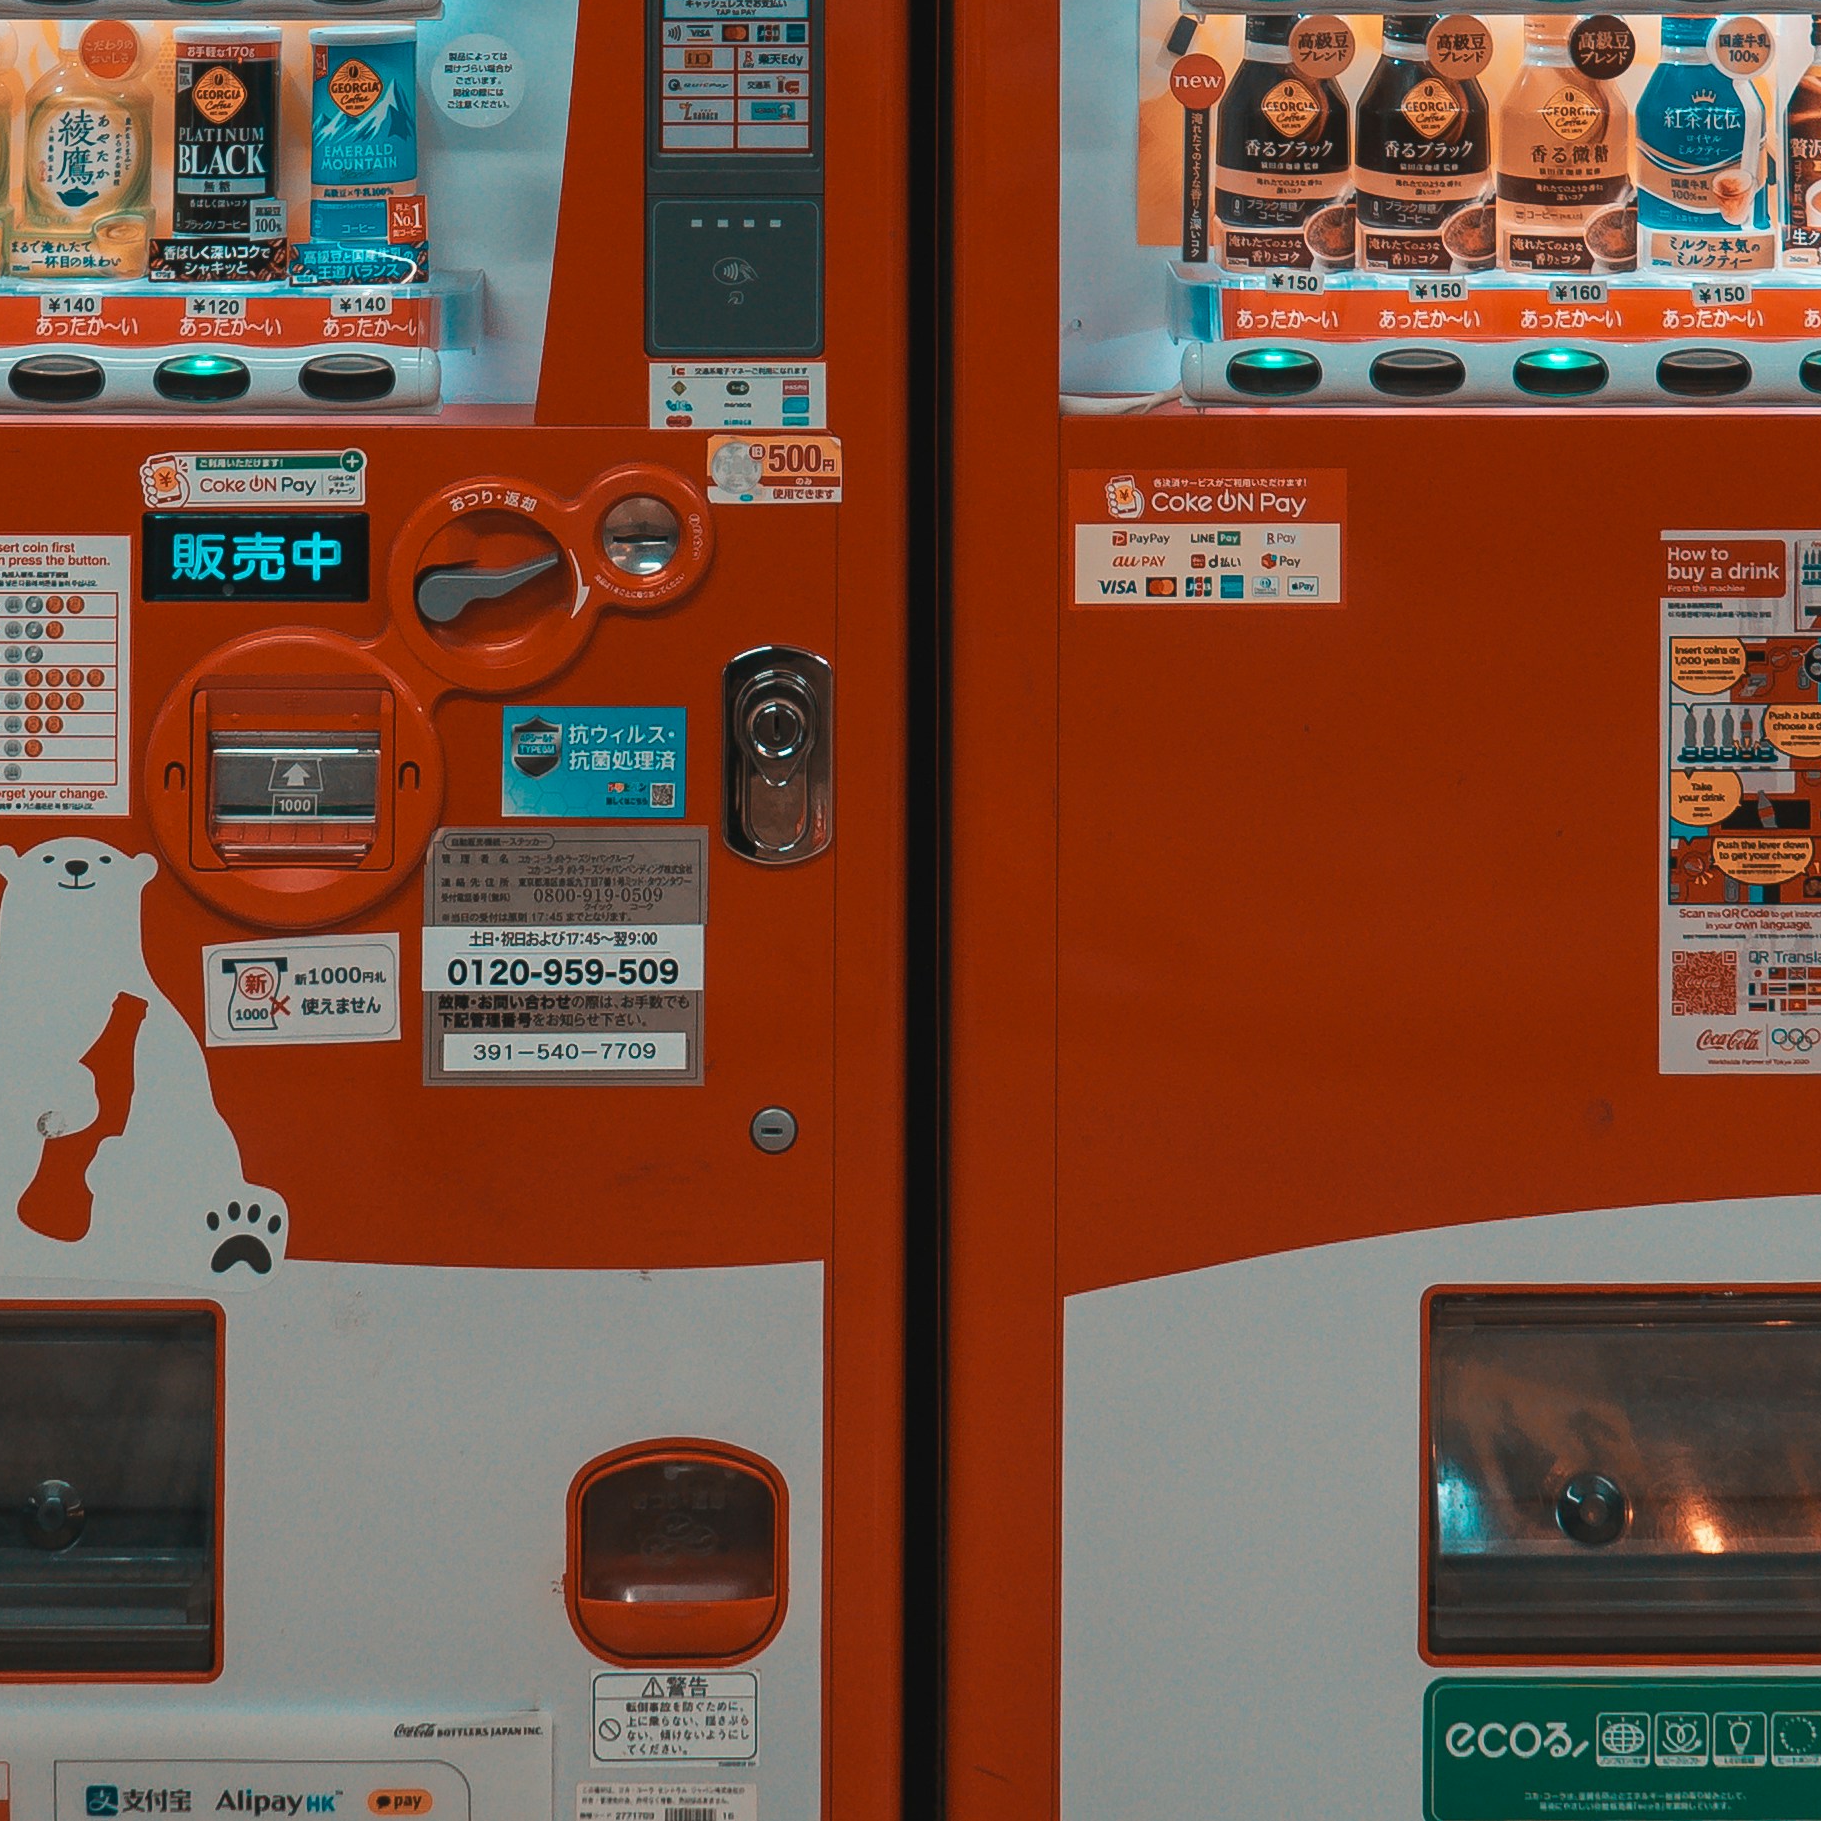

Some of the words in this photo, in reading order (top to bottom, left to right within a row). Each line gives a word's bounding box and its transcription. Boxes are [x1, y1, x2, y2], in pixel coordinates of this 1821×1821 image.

[1174, 74, 1222, 89] new
[1245, 139, 1333, 159] 香るブラック
[178, 143, 265, 176] BLACK
[449, 490, 537, 513] おつり・返却
[1151, 491, 1214, 513] Coke
[1259, 492, 1307, 517] Pay
[24, 542, 48, 554] coin
[52, 541, 76, 554] first
[172, 531, 343, 582] 販売中
[1667, 547, 1704, 562] How
[1709, 548, 1729, 562] to
[569, 748, 676, 772] 抗菌処理済
[534, 886, 664, 904] 0800-919-0509
[447, 958, 679, 986] 0120-959-509
[301, 997, 382, 1016] 使えません
[667, 1677, 708, 1697] 警告
